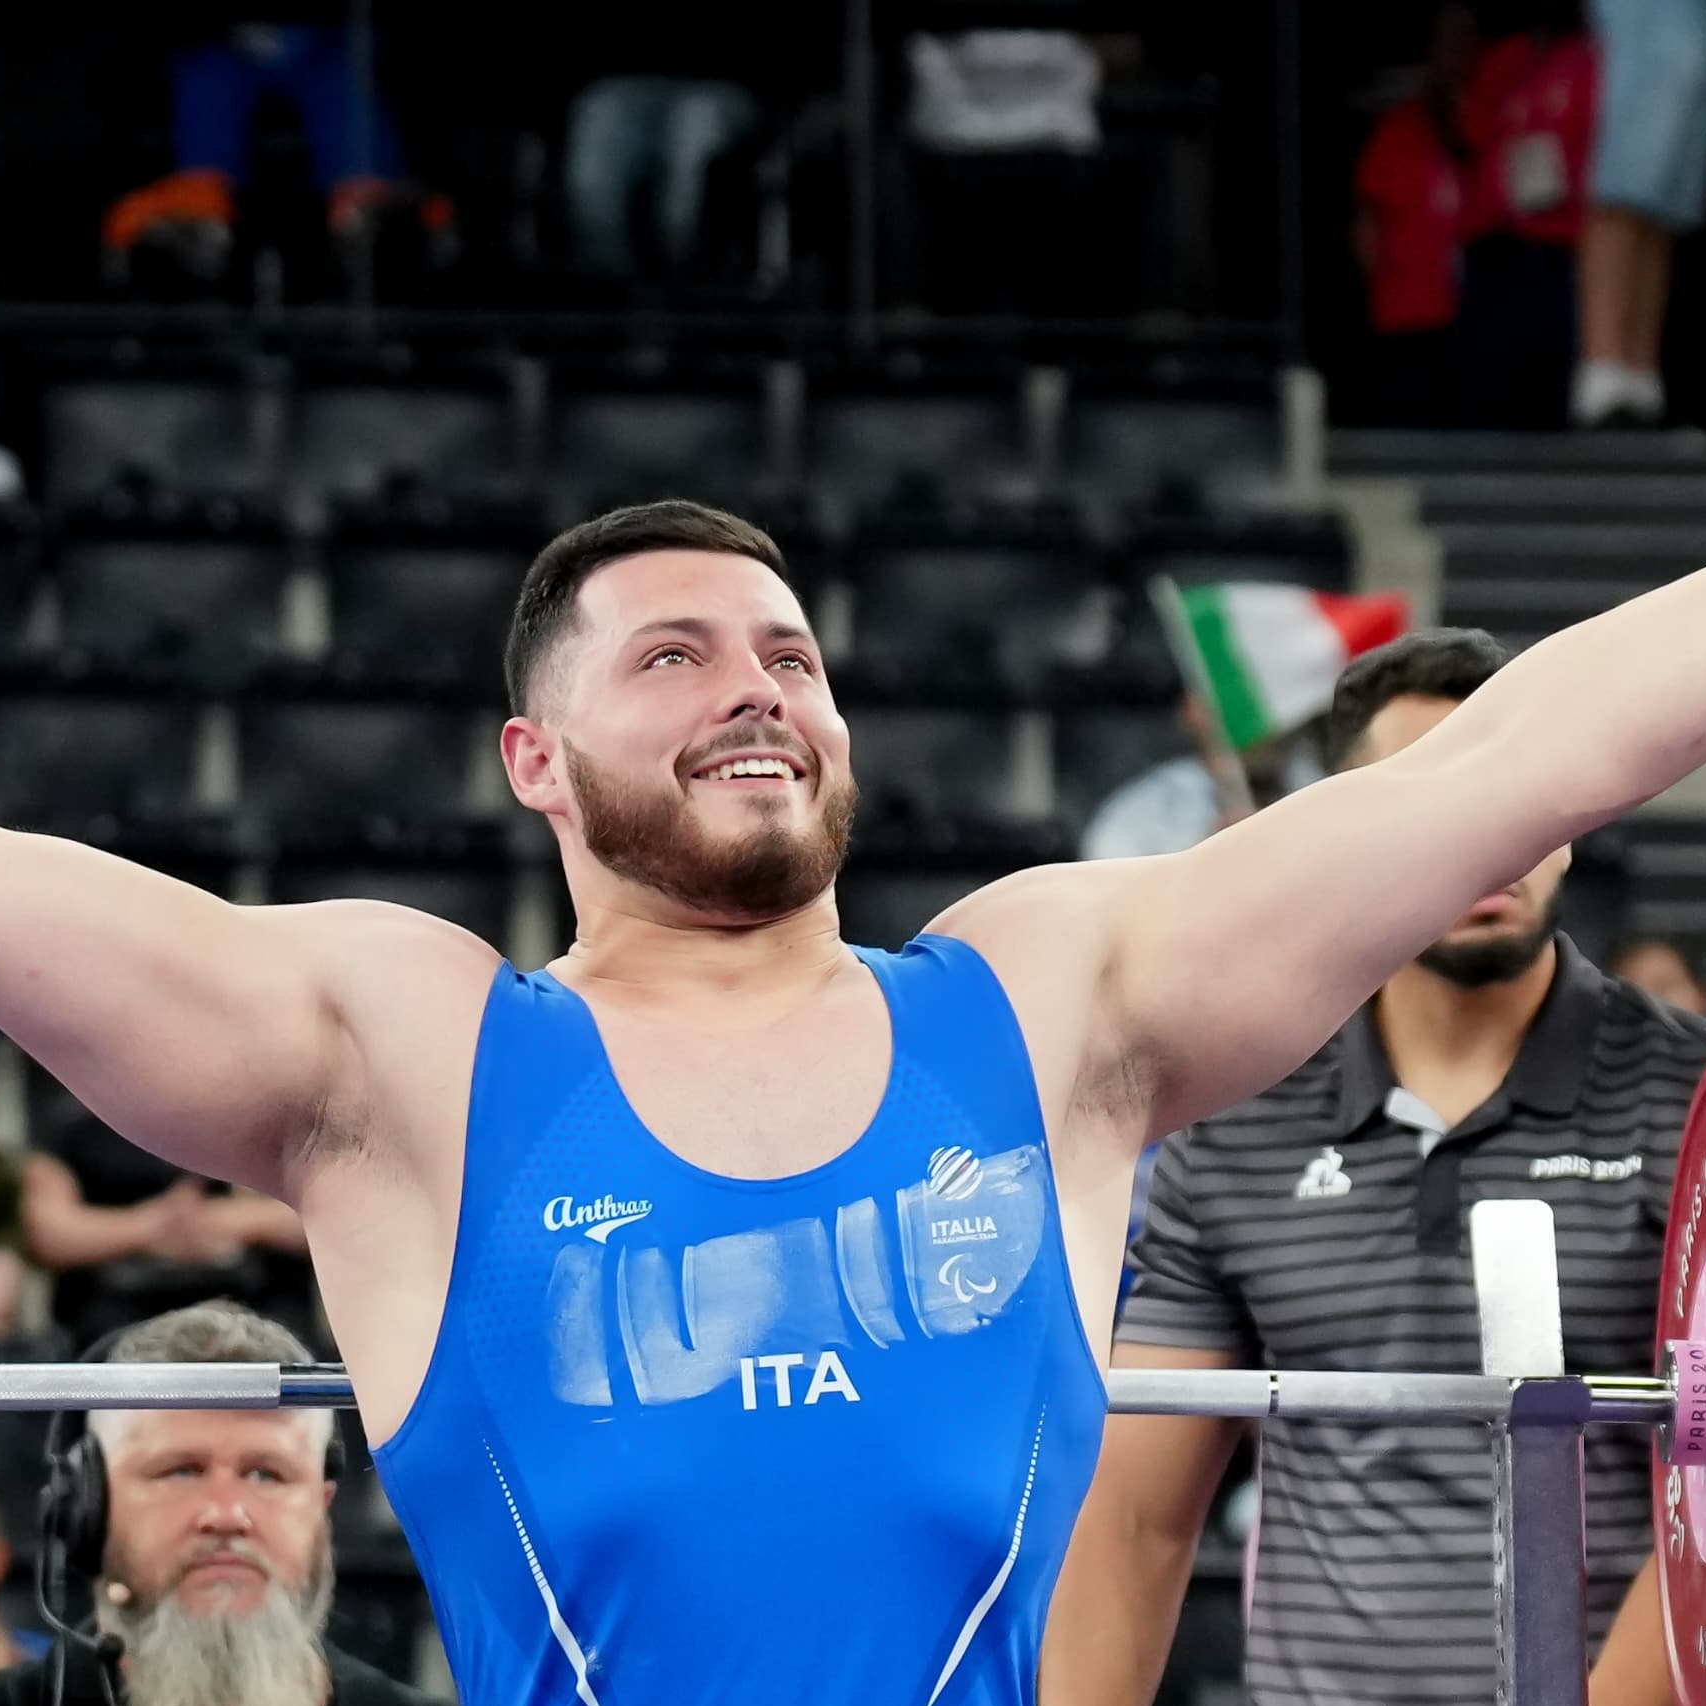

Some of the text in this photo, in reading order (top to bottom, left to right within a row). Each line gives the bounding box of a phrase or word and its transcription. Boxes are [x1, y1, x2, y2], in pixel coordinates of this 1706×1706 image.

[543, 1193, 654, 1232] Anthrax
[930, 1215, 998, 1238] ITALIA
[740, 1350, 861, 1411] ITA
